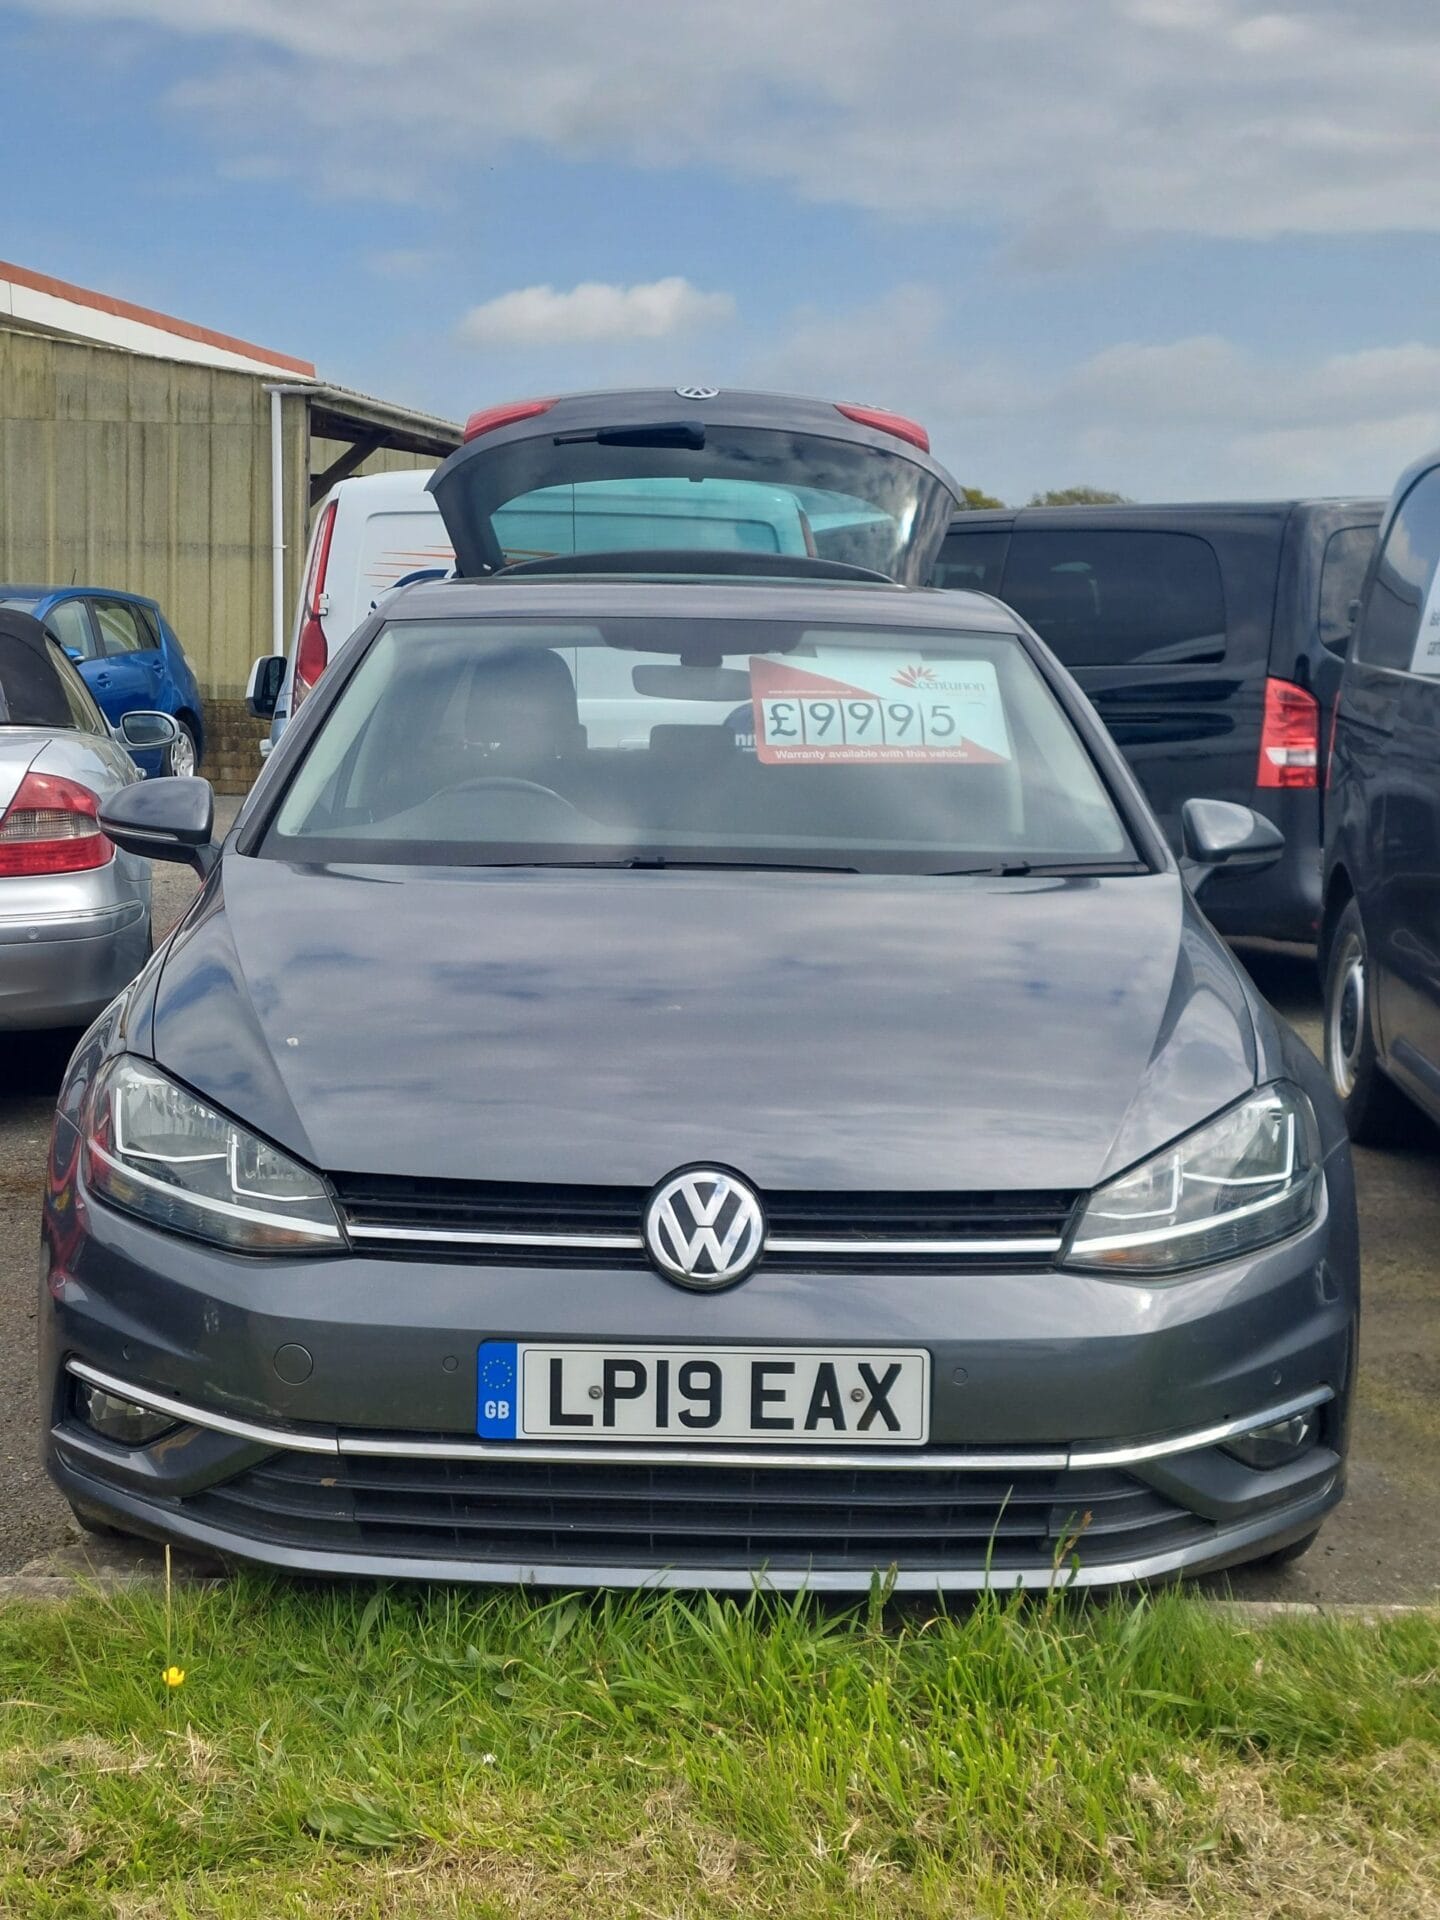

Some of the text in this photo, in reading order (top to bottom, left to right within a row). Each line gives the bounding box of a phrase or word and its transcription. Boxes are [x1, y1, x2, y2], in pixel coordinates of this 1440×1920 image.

[769, 702, 956, 738] £9995
[775, 748, 968, 760] Warranty available with this vehicle
[549, 1357, 902, 1432] LP19 EAX
[484, 1400, 510, 1419] GB
